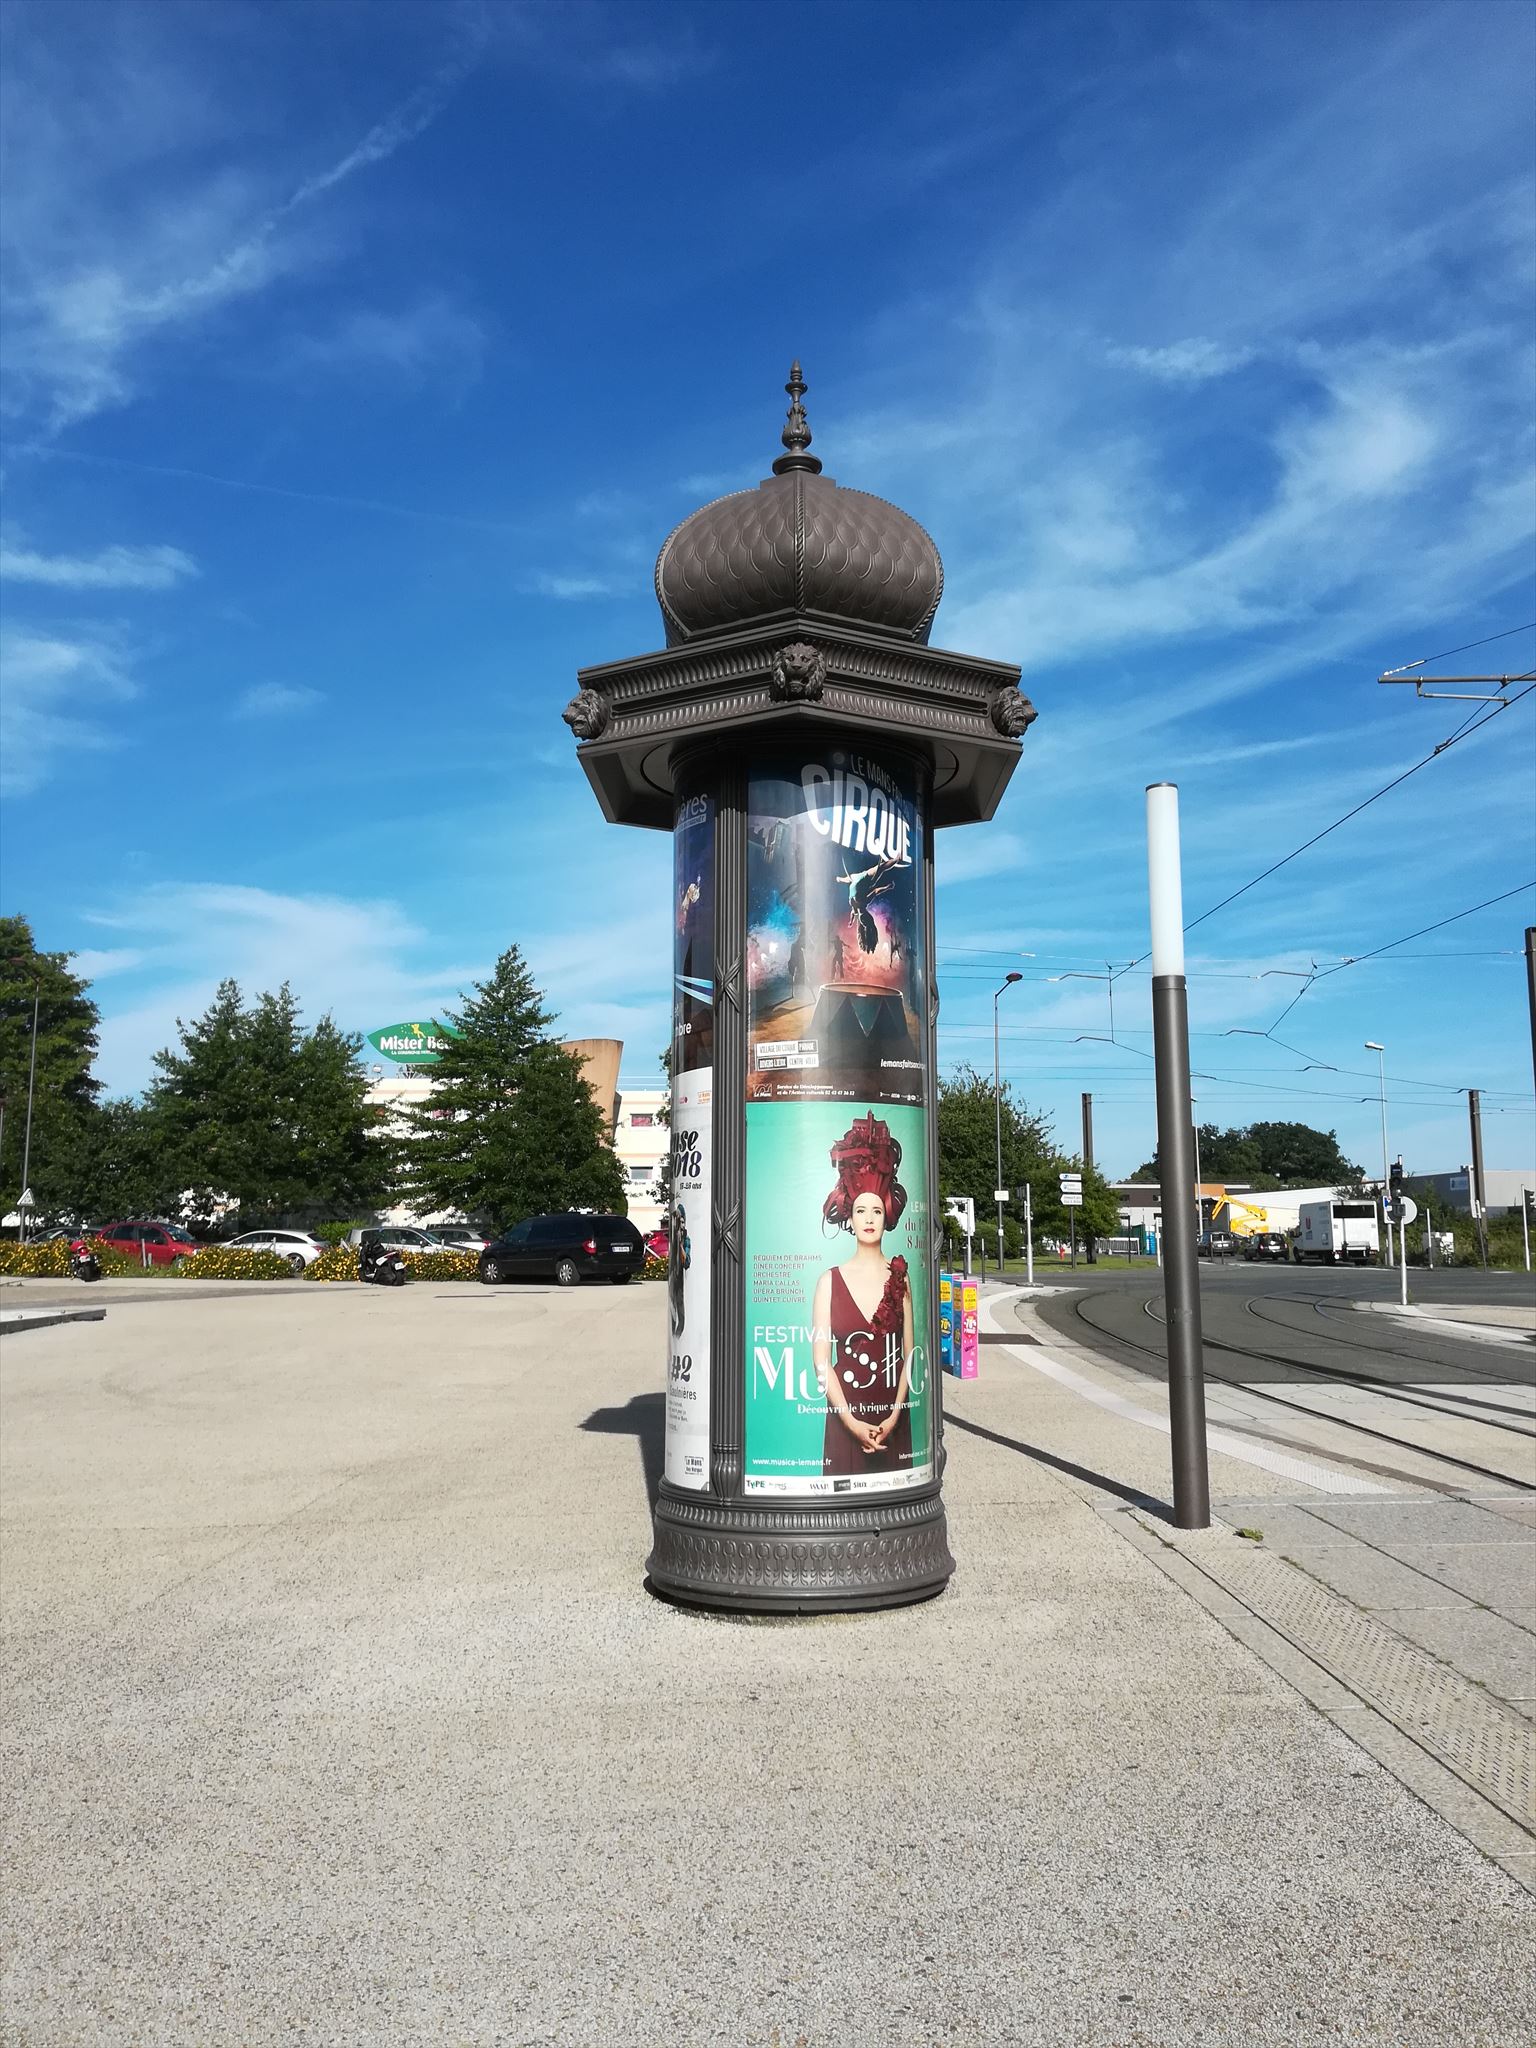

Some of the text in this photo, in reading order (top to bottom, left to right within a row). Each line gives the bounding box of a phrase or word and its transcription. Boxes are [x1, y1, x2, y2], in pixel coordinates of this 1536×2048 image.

[850, 754, 866, 776] LE
[866, 760, 892, 793] MANS
[801, 764, 912, 864] CIRQUE
[380, 1035, 424, 1051] Mister
[910, 1201, 919, 1213] LE
[905, 1217, 915, 1232] du
[753, 1254, 782, 1262] REQUIEM
[794, 1254, 823, 1262] BRAHMS
[754, 1325, 838, 1343] FESTIVAL
[671, 1354, 693, 1383] #2
[797, 1402, 847, 1415] Découvrir
[848, 1402, 858, 1413] le
[859, 1401, 889, 1416] lyrique
[752, 1457, 832, 1467] www.musica-lemans.fr
